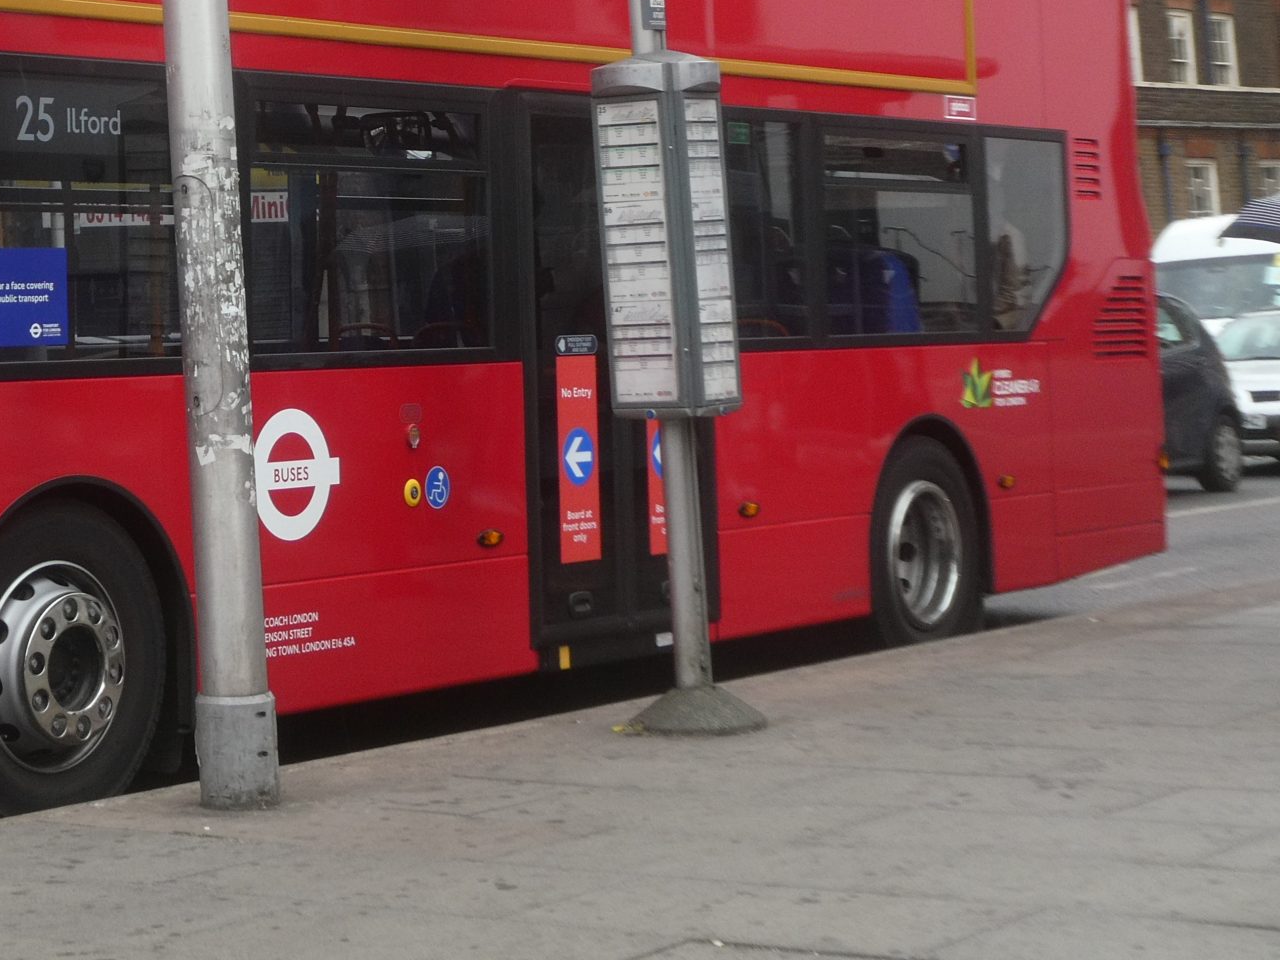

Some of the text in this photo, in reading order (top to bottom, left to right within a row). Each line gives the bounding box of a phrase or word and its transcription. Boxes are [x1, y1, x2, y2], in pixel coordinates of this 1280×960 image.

[16, 95, 121, 142] 25 Ilford
[251, 195, 288, 220] Mini
[10, 281, 25, 290] face
[26, 281, 54, 291] covering
[18, 295, 48, 304] transport
[561, 387, 592, 399] No Entry
[274, 466, 309, 483] BUSES
[264, 612, 319, 628] COACH LONDON
[264, 627, 312, 643] ENSON STREET
[301, 640, 331, 653] LONDON
